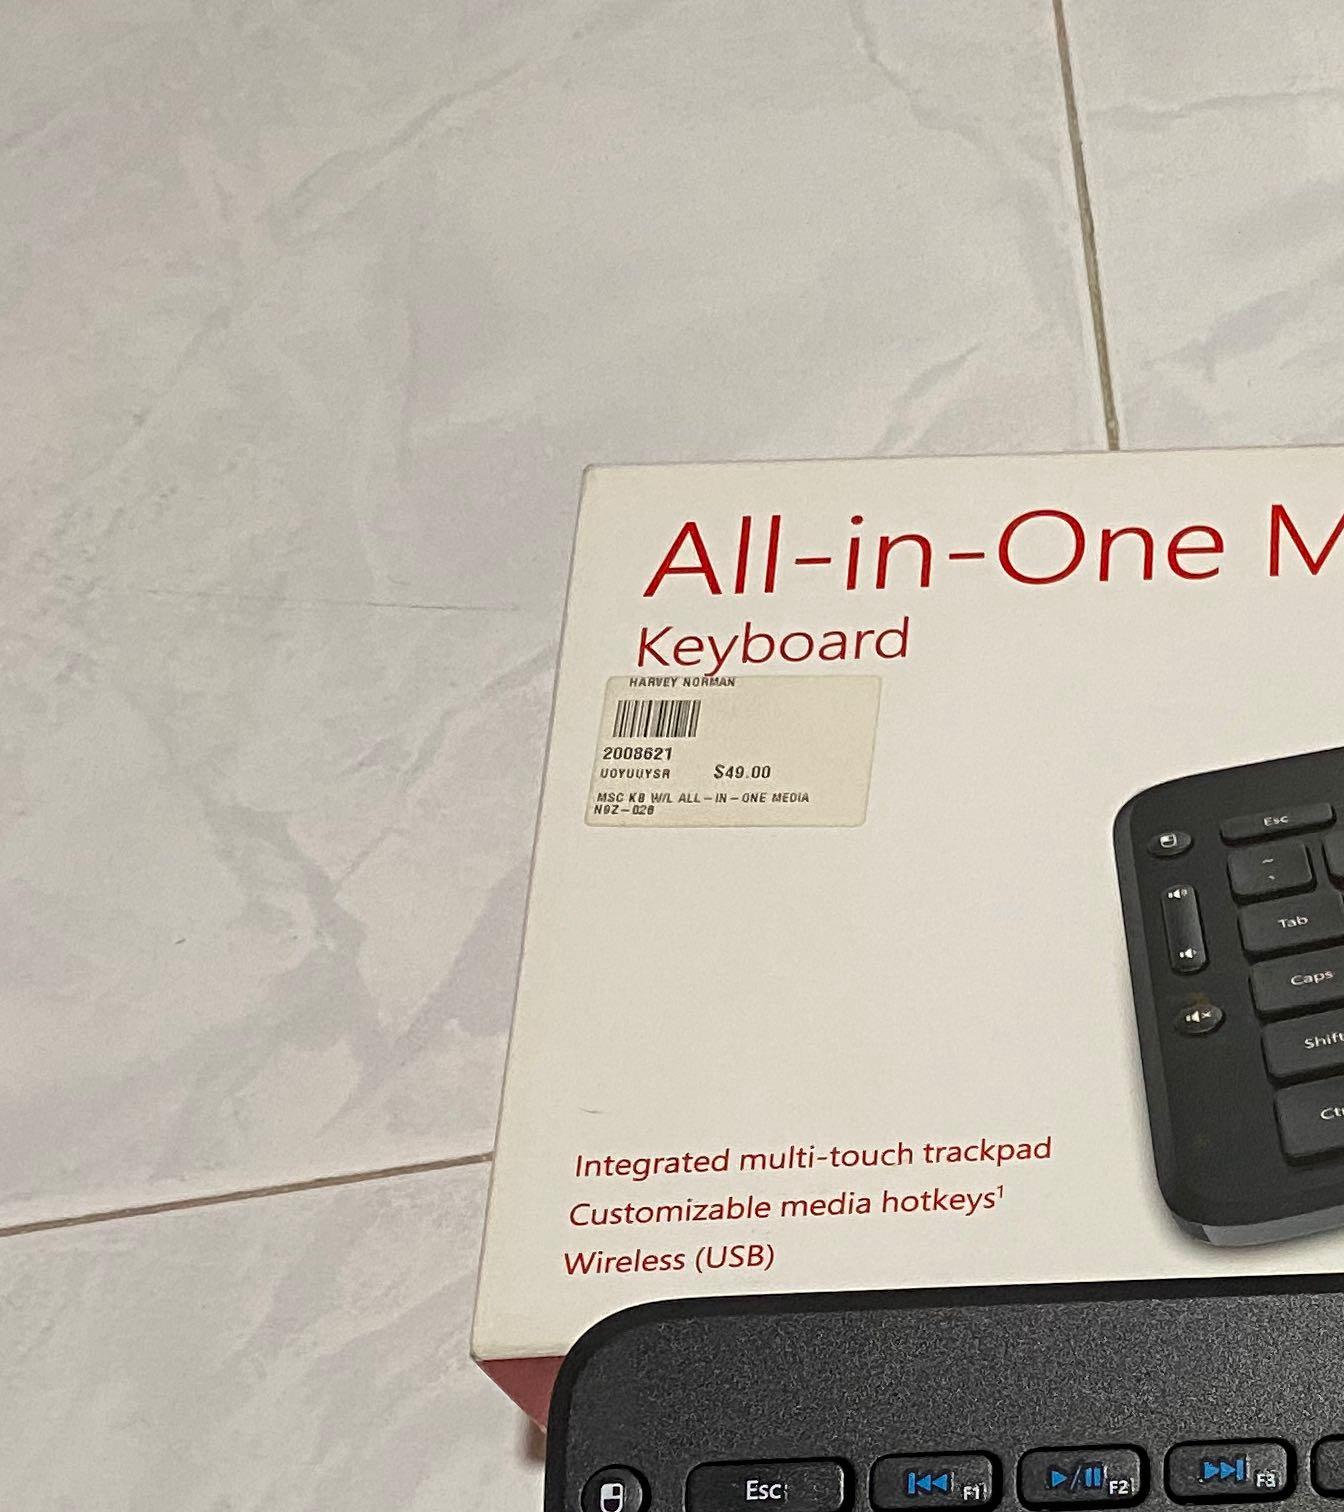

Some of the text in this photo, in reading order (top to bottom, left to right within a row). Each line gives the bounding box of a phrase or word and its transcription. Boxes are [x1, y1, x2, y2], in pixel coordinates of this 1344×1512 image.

[642, 508, 1225, 598] All-in-One
[636, 616, 910, 679] Keyboard
[629, 677, 736, 687] HARVEY NORMAN
[603, 747, 672, 760] 2008621
[714, 765, 771, 779] $49.00
[597, 793, 624, 803] MSC
[628, 793, 646, 803] KB
[772, 792, 809, 803] MEDIA
[1264, 814, 1288, 827] Esc
[1278, 914, 1309, 928] Tab
[1290, 968, 1334, 988] Caps
[575, 1137, 1052, 1183] Integrated multi-touch trackpad
[569, 1195, 771, 1227] Customizable
[780, 1192, 872, 1218] media
[564, 1243, 774, 1276] Wireless (USB)
[1109, 1479, 1130, 1495] F2
[1256, 1473, 1277, 1488] F3
[746, 1480, 782, 1502] Esc
[963, 1485, 982, 1501] F1
